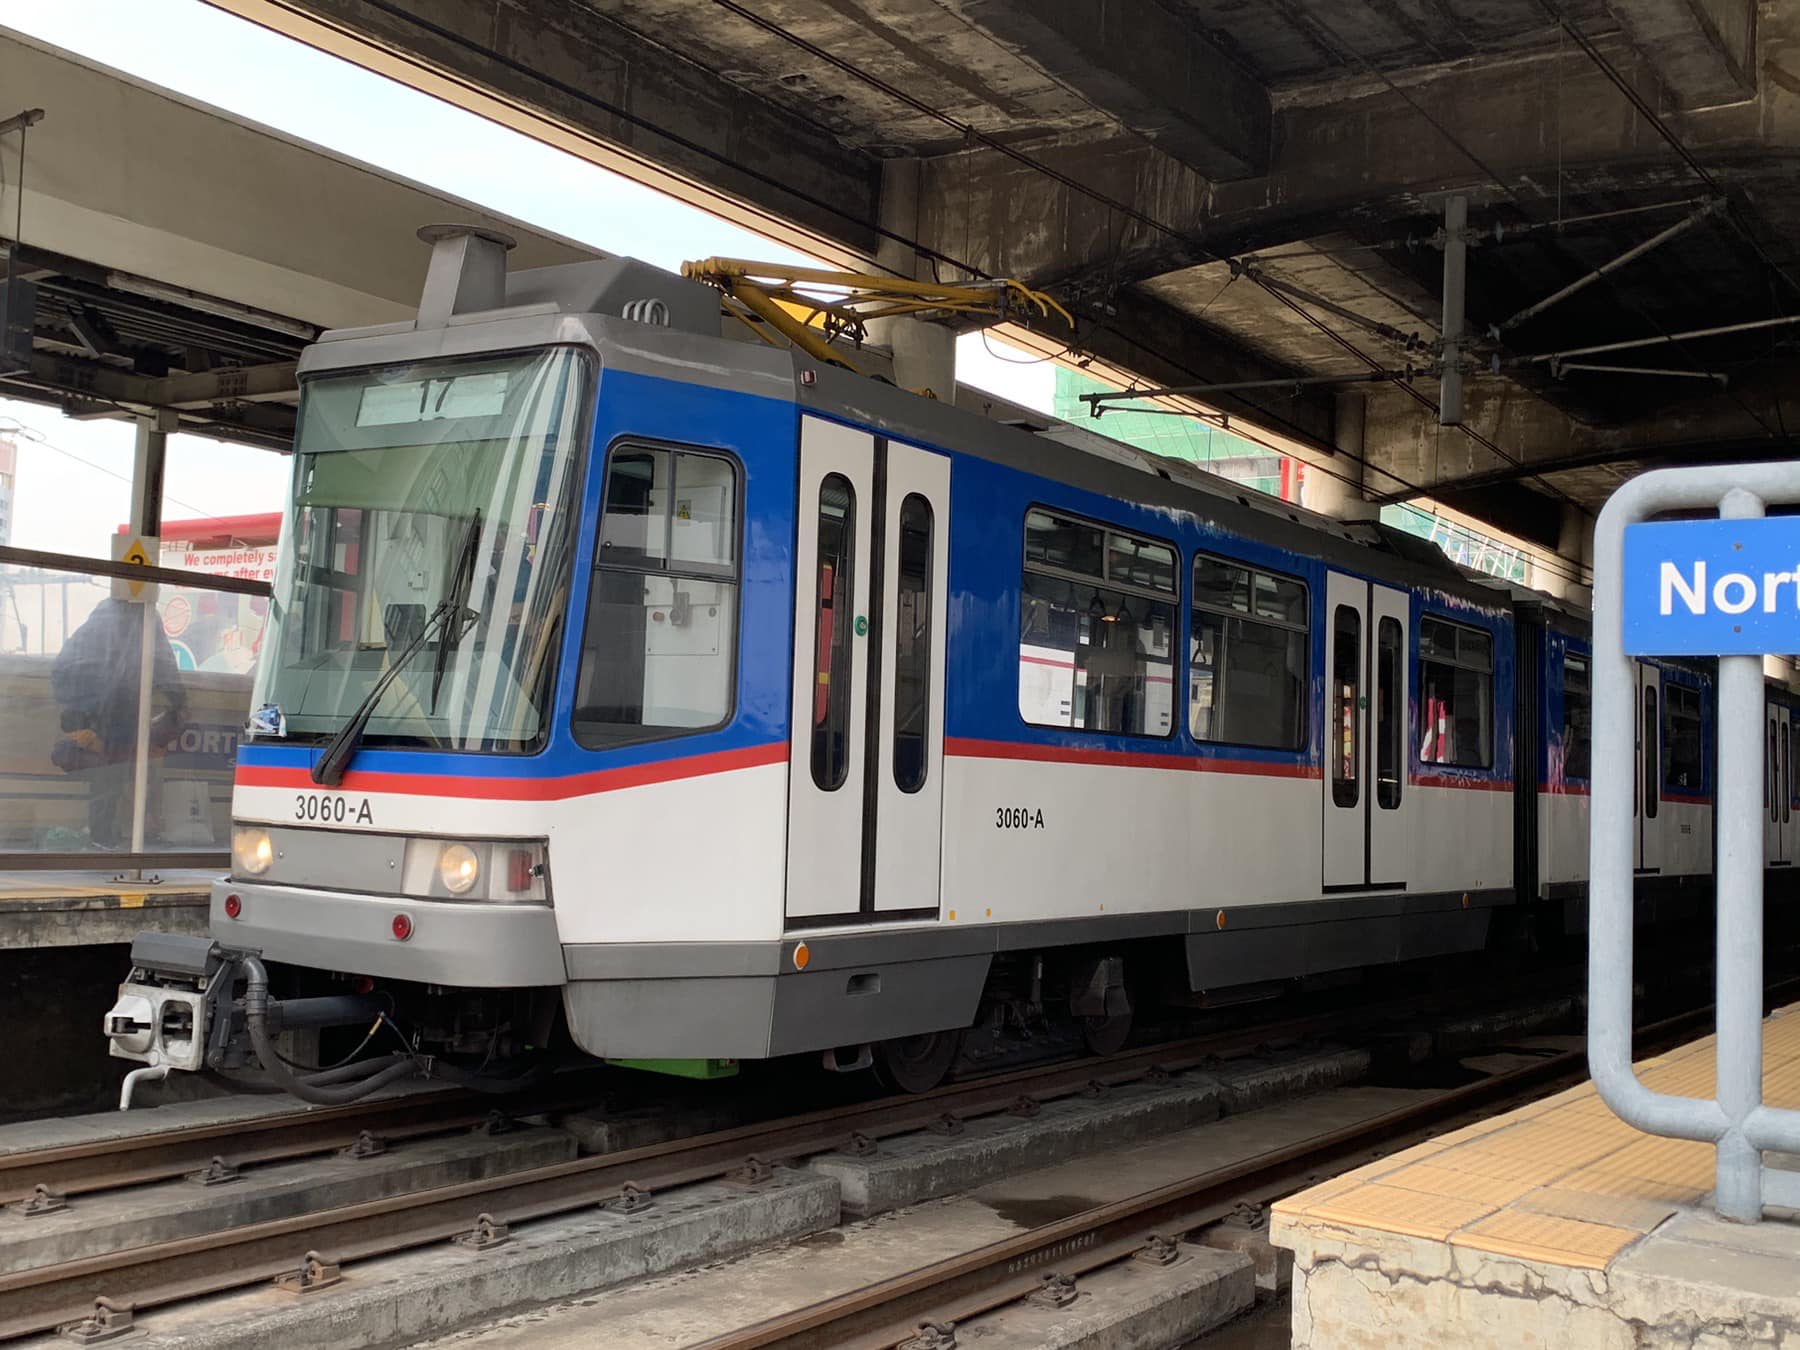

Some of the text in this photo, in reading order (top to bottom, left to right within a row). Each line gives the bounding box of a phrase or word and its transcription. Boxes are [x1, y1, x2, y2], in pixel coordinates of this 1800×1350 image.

[420, 377, 456, 413] 17
[185, 551, 200, 567] We
[203, 548, 264, 568] completely
[168, 727, 243, 754] ORT
[295, 795, 373, 825] 3060-A
[996, 807, 1044, 829] 3060-A
